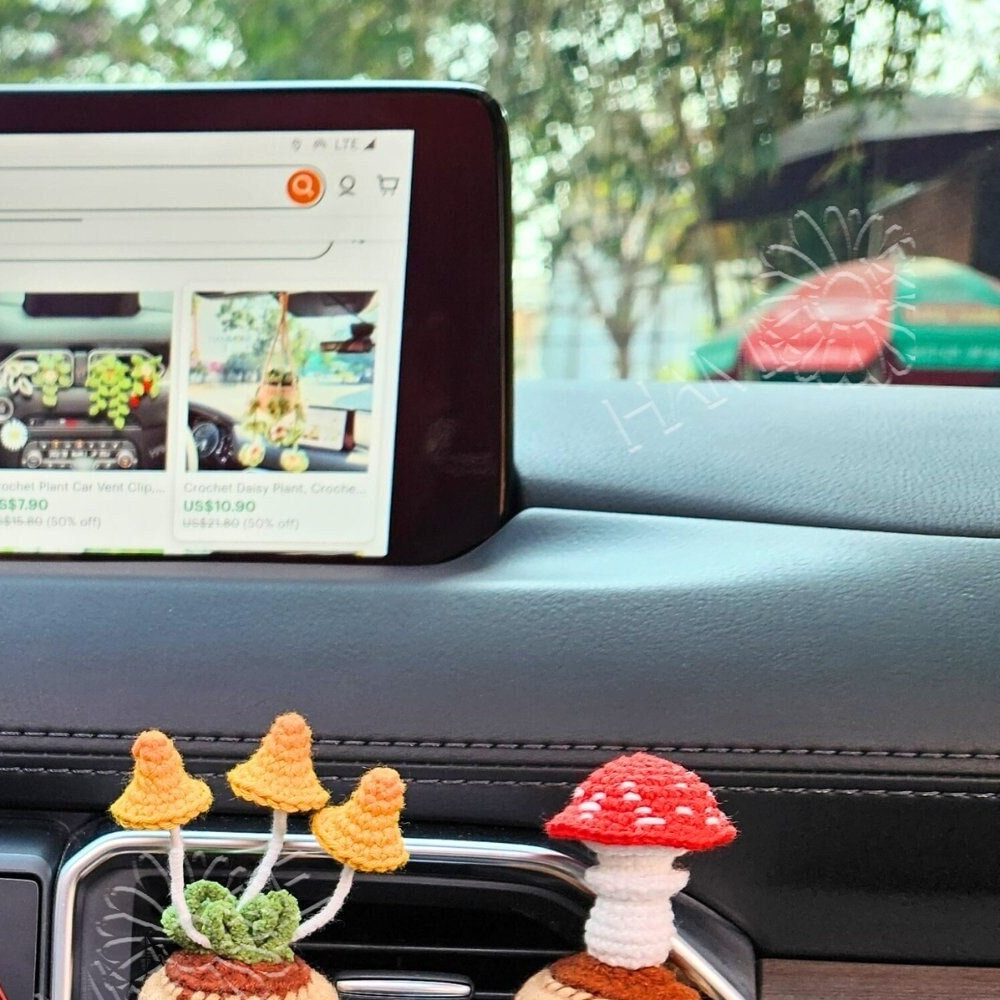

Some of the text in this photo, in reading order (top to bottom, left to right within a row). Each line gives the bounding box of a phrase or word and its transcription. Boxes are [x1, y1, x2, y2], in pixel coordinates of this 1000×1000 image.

[39, 481, 69, 493] Plant
[72, 482, 93, 493] Car
[96, 482, 125, 493] Vent
[183, 482, 233, 494] Crochet
[236, 482, 269, 496] Daisy
[183, 500, 257, 513] US$10.90
[79, 516, 102, 528] off)
[277, 518, 300, 530] off)
